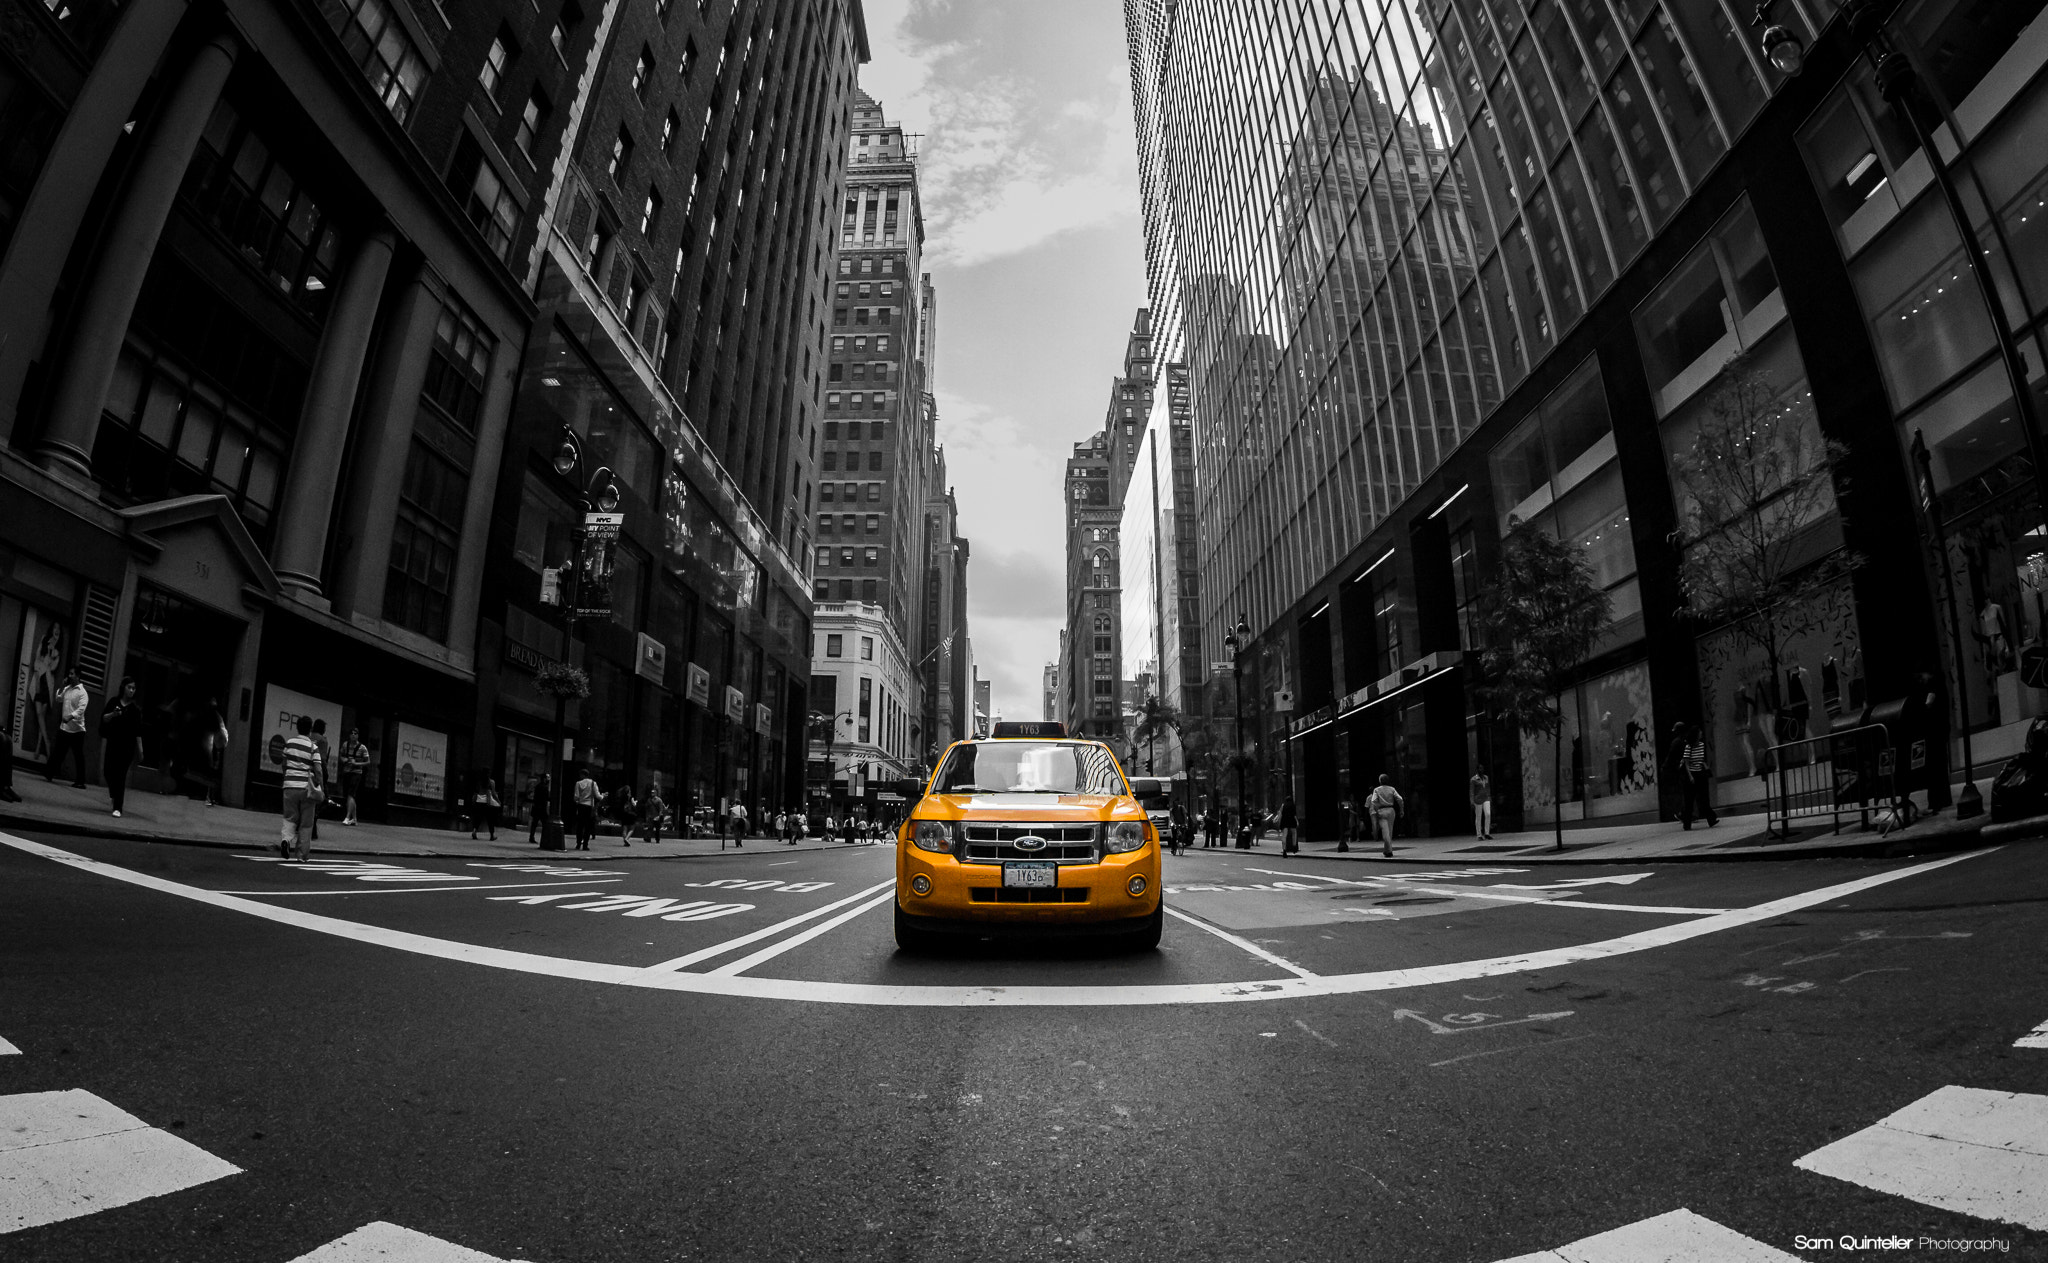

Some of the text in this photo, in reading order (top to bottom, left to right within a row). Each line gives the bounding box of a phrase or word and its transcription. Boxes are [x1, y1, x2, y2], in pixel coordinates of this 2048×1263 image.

[510, 642, 538, 668] BREAD
[13, 663, 30, 744] Love Pumps
[1019, 725, 1040, 736] 1Y63
[1780, 716, 1800, 741] 70
[402, 741, 442, 765] RETAIL
[683, 879, 836, 894] BUS
[484, 891, 758, 923] ONLY
